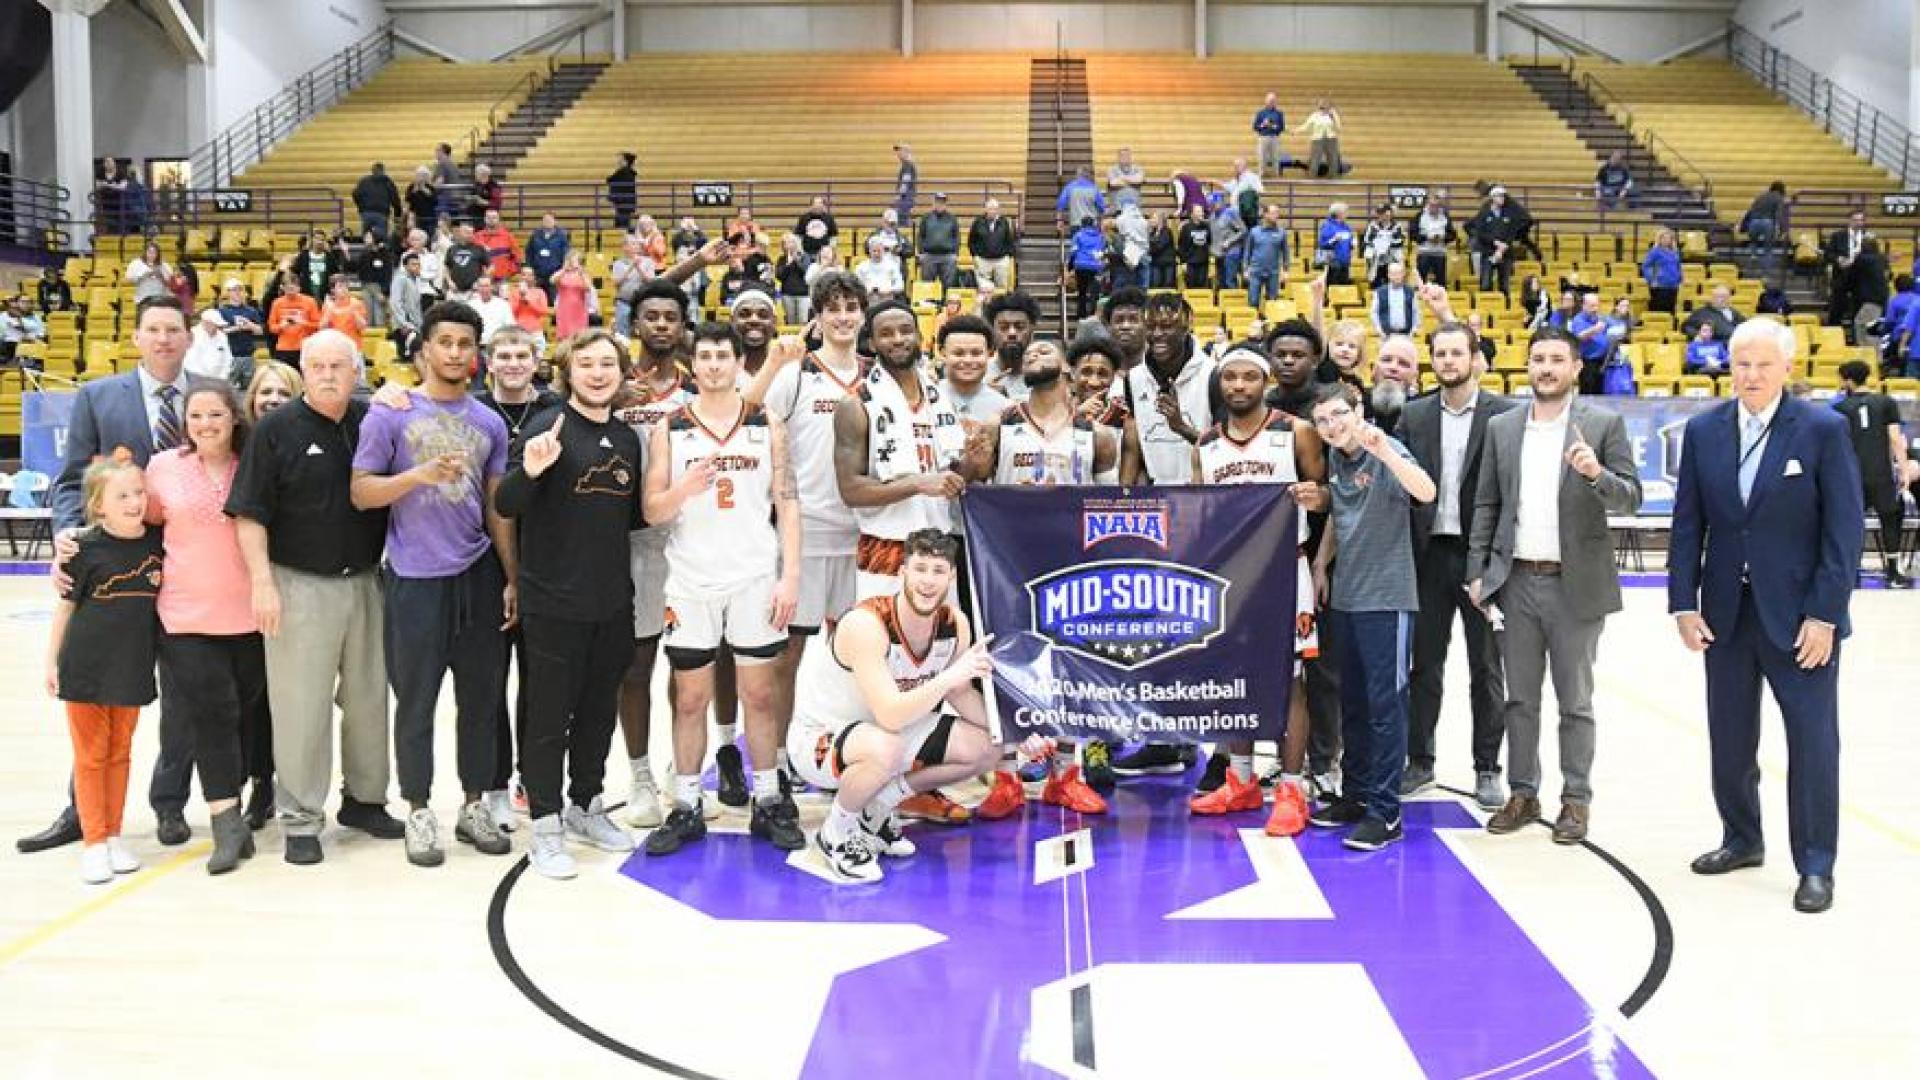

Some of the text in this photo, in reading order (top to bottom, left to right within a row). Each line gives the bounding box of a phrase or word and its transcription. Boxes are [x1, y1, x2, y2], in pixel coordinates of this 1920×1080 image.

[1859, 405, 1868, 428] 1
[716, 478, 735, 508] 2
[1086, 513, 1164, 542] NAIA
[1044, 573, 1212, 625] MID-SOUTH
[1063, 621, 1194, 636] CONFERENCE
[1078, 680, 1137, 702] Men's
[1139, 678, 1247, 702] Basketball
[1014, 705, 1260, 735] Conference Champions
